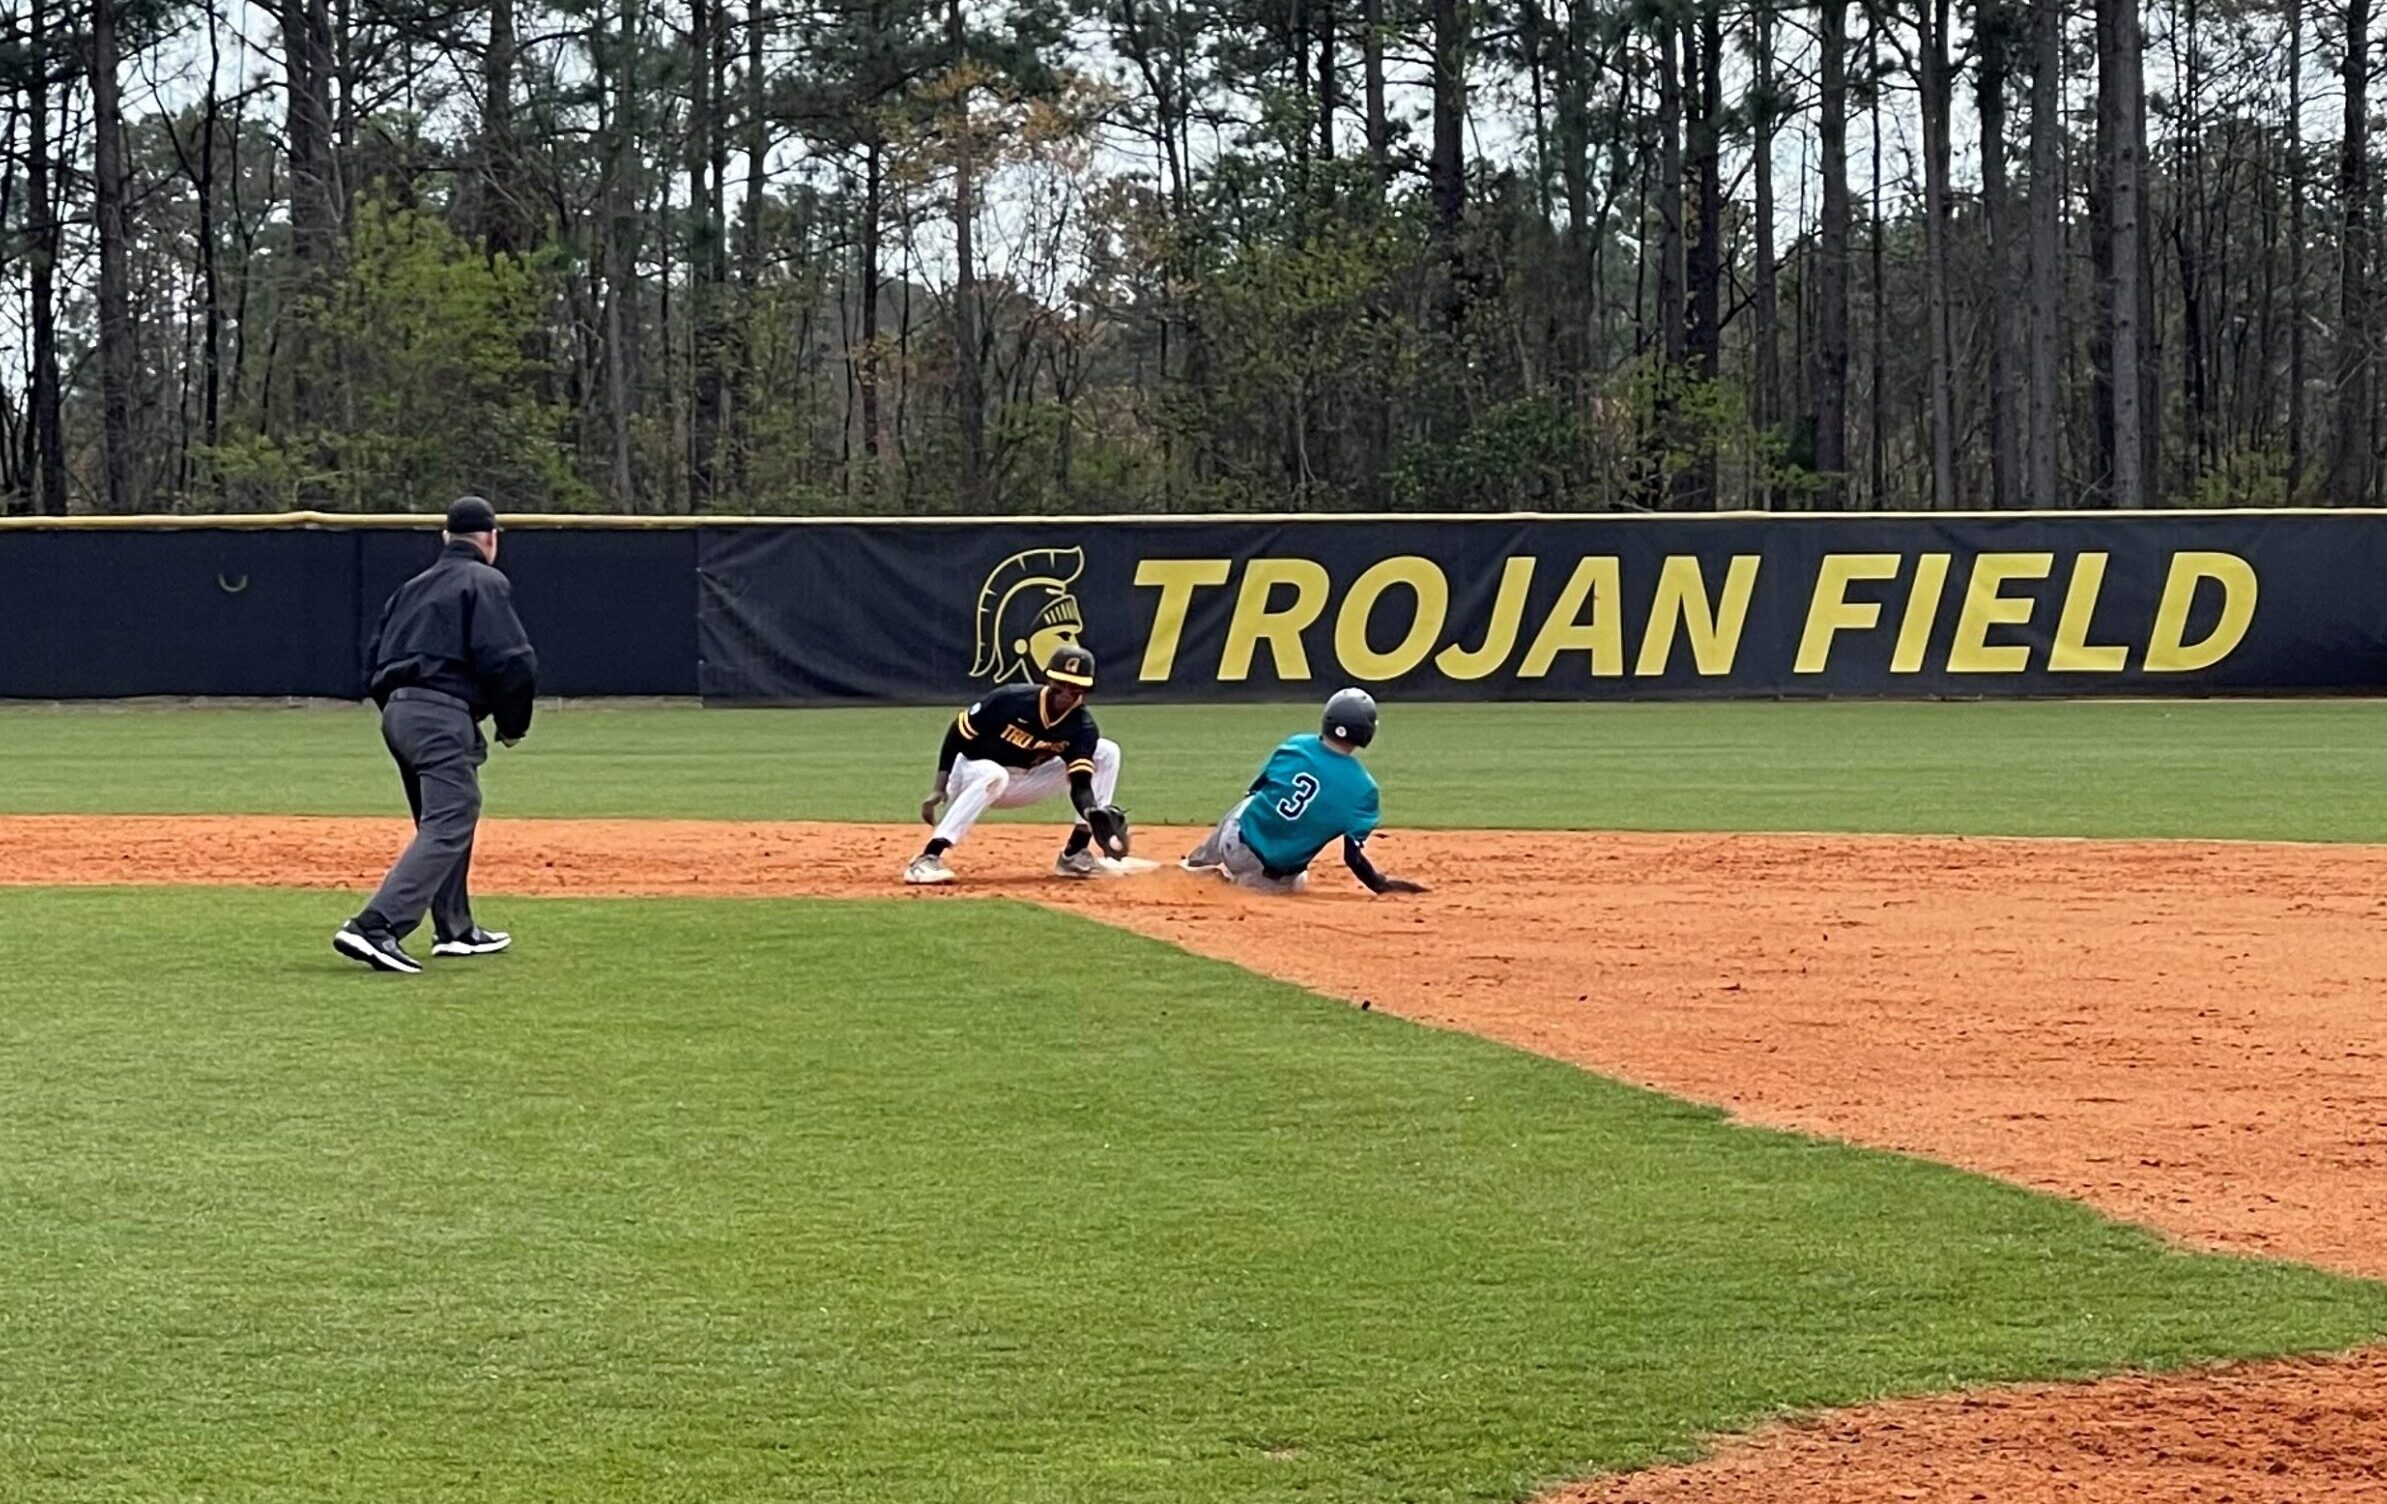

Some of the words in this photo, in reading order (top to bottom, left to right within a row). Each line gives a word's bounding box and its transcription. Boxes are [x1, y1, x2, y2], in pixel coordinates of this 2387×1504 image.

[1134, 555, 1760, 681] TROJAN
[1794, 551, 2258, 673] FIELD
[1277, 772, 1320, 820] 3
